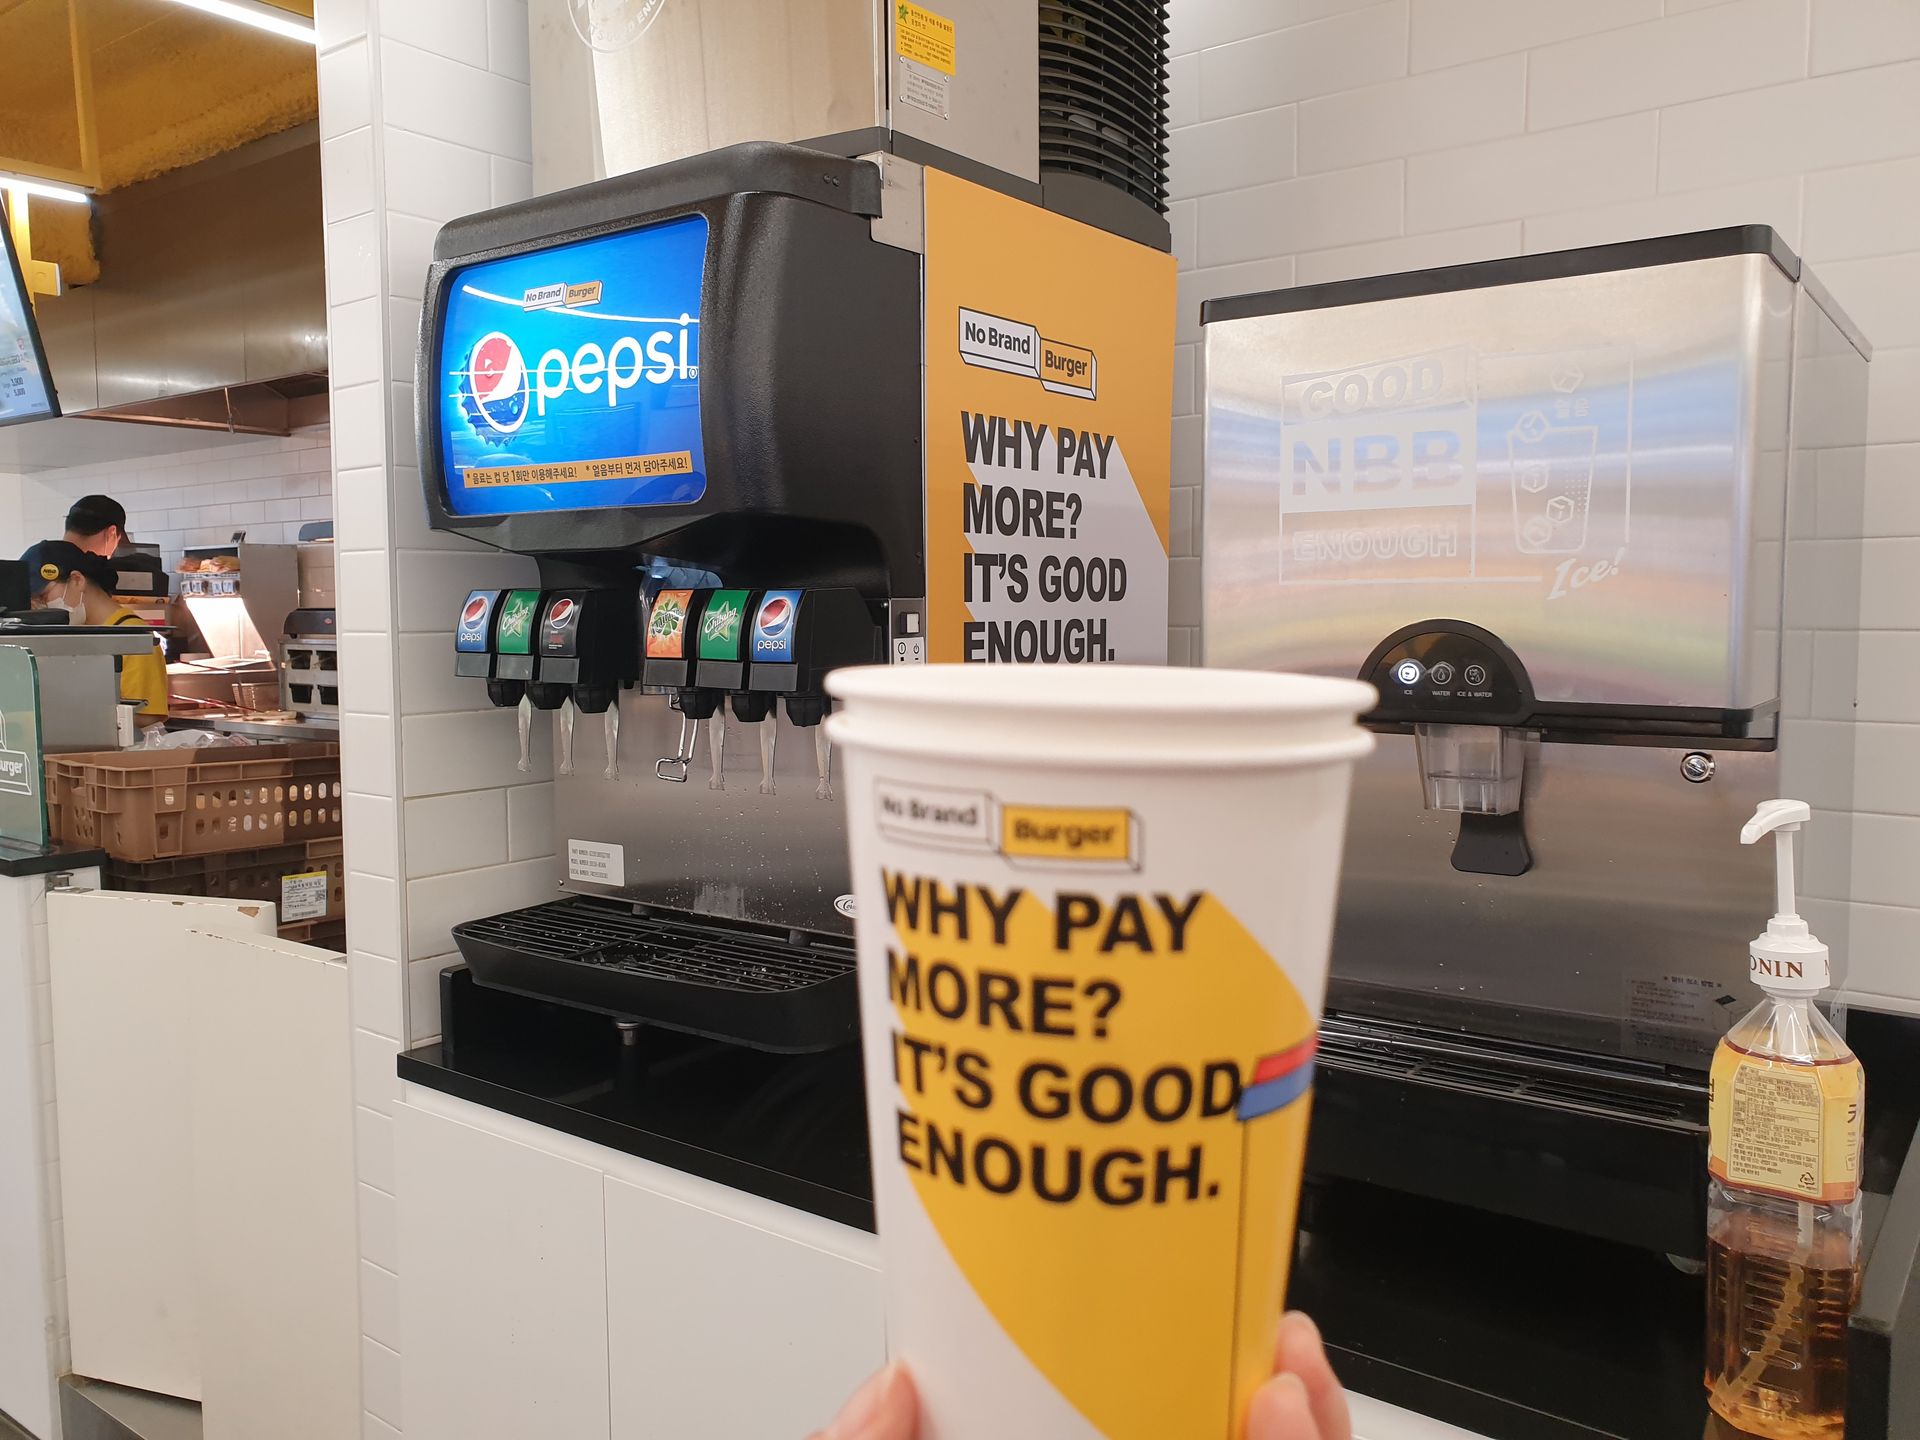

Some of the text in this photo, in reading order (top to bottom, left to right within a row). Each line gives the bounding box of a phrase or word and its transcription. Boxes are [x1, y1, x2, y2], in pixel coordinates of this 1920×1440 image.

[526, 287, 562, 303] No Brand
[568, 285, 596, 299] Burger
[964, 321, 1031, 355] No Brand
[537, 312, 688, 416] pepsi
[1044, 350, 1088, 378] Burger
[1302, 358, 1443, 420] GOOD
[961, 410, 1115, 480] WHY PAY
[1292, 430, 1463, 496] NBB
[472, 472, 493, 485] 음료는
[502, 470, 510, 483] 당
[511, 468, 530, 482] 1회만
[531, 466, 577, 481] 이용해주세요!
[592, 456, 688, 478] 얼음부터 먼저 담아주세요!
[963, 482, 1083, 540] MORE?
[1293, 522, 1458, 562] ENOUGH
[1039, 555, 1128, 603] GOOD
[1545, 546, 1625, 600] Ice!
[460, 631, 482, 643] pepsi
[757, 638, 787, 652] pepsi
[963, 618, 1116, 665] ENOUGH.
[1456, 690, 1466, 698] ICE
[1473, 691, 1493, 699] WATER
[908, 802, 978, 828] Brand
[1013, 817, 1116, 849] Burger
[880, 865, 1203, 953] WHY PAY
[887, 949, 1122, 1038] MORE?
[1016, 1061, 1243, 1124] GOOD
[896, 1110, 1220, 1207] ENOUGH.
